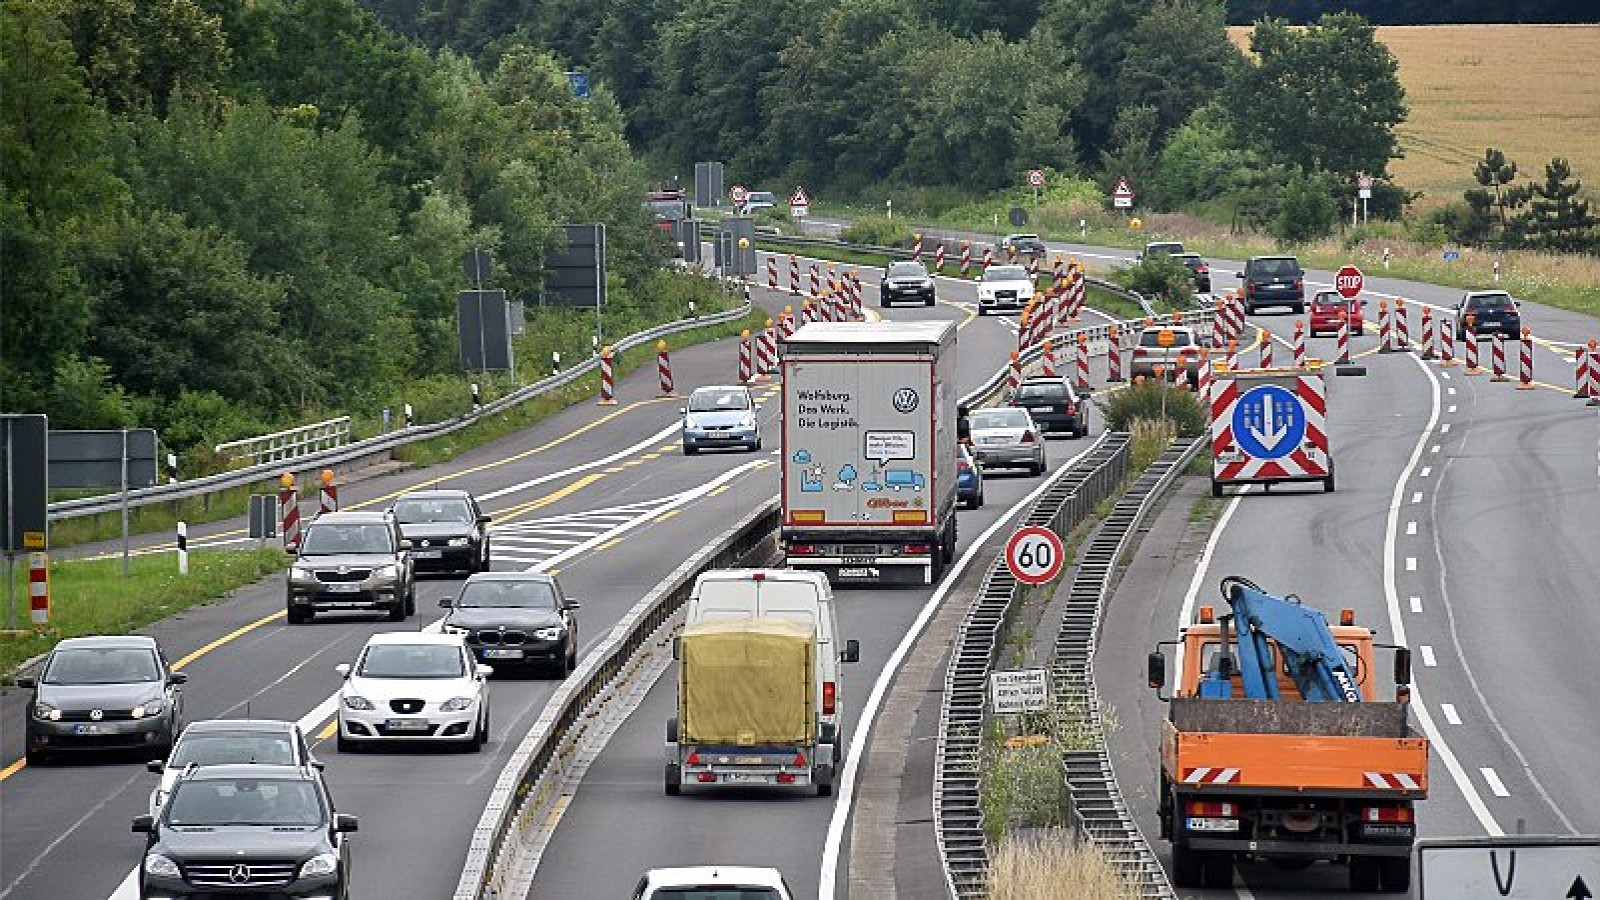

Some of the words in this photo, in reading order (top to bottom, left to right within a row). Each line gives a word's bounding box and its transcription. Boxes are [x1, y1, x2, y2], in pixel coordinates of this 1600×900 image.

[1338, 275, 1361, 289] STOP
[798, 403, 818, 415] Das
[820, 403, 850, 415] Werk.
[798, 417, 816, 429] Die
[1019, 543, 1050, 568] 60
